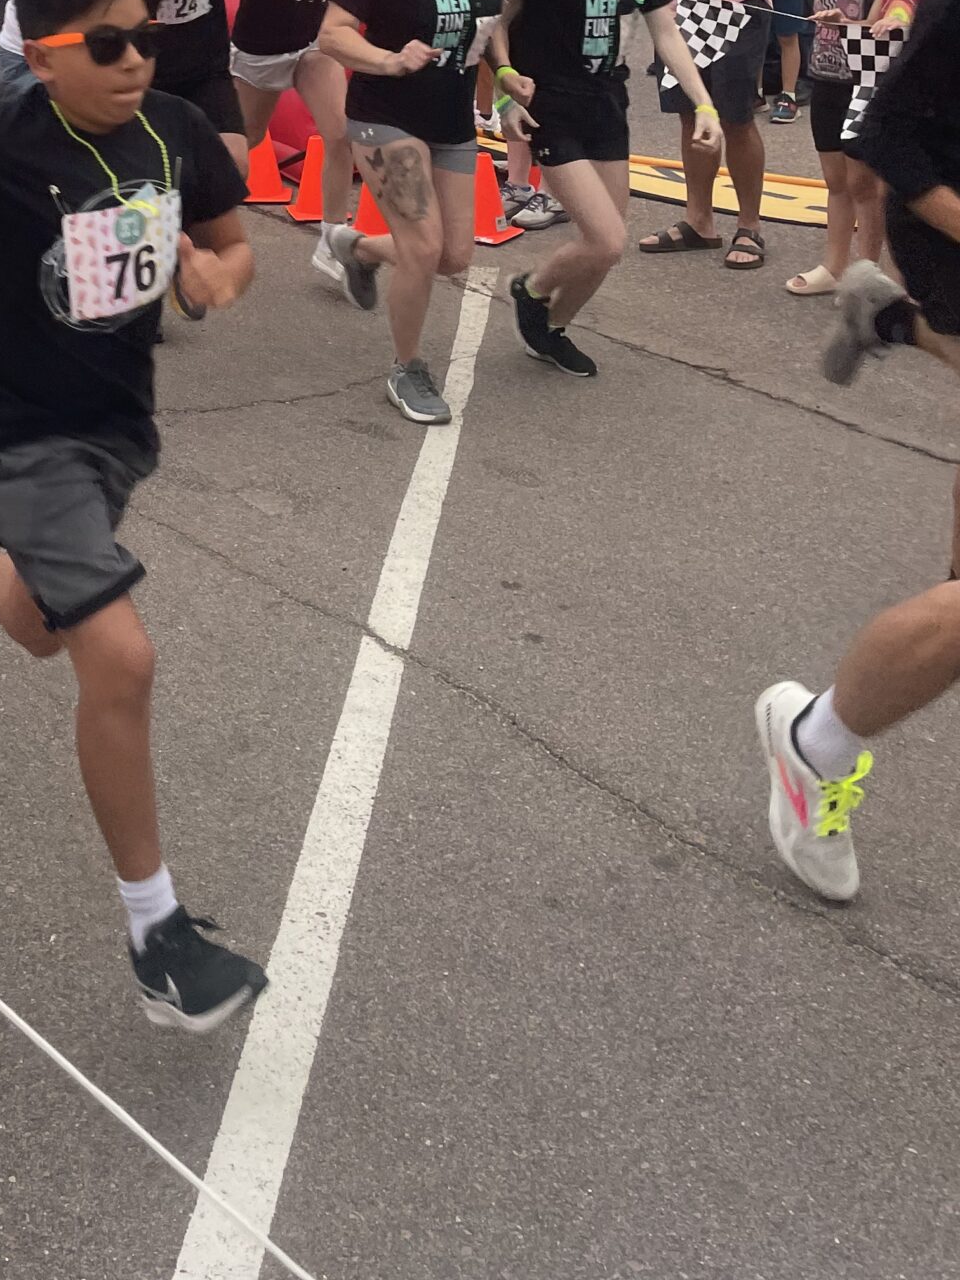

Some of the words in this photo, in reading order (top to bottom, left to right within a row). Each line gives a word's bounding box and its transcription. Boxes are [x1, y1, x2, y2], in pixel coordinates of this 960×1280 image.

[436, 13, 464, 32] FUN
[585, 18, 609, 37] FUN
[105, 244, 157, 300] 76
